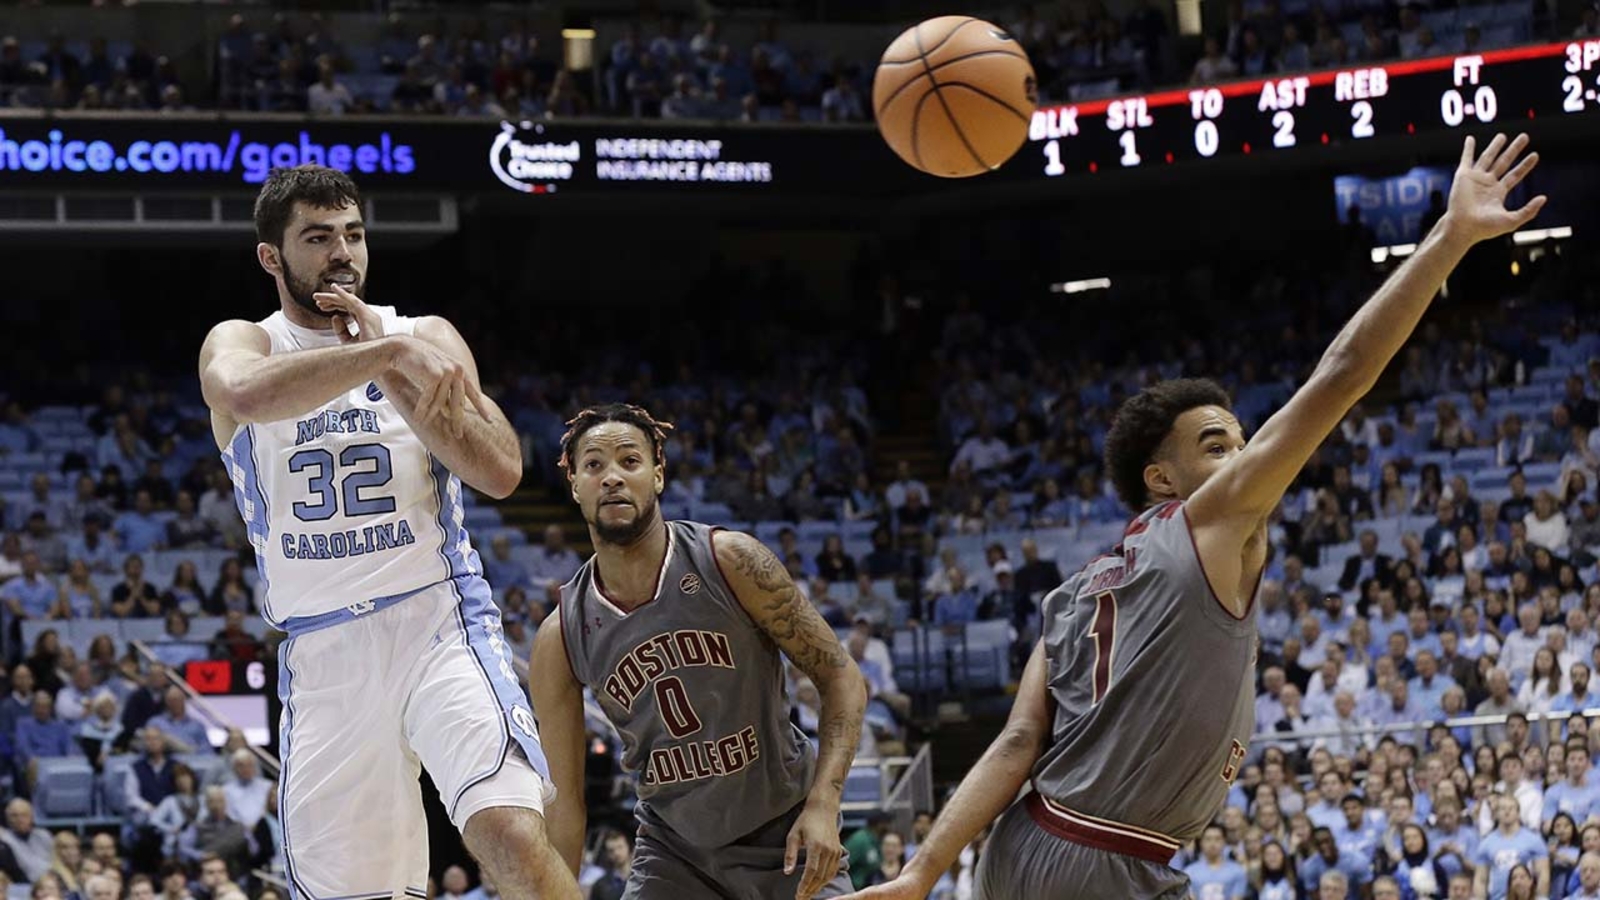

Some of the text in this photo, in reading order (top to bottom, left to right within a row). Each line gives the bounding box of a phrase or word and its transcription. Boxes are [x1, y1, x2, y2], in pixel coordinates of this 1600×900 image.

[1029, 40, 1600, 141] BLK STL TO AST REB FT 3P
[595, 138, 722, 160] INDEPENDENT
[1043, 139, 1065, 176] 1
[1119, 130, 1141, 167] 1
[1194, 119, 1219, 157] 0
[1272, 110, 1296, 148] 2
[1351, 101, 1375, 138] 2
[1440, 85, 1498, 127] 0-0
[596, 161, 773, 182] INSURANCE AGENTS
[295, 408, 381, 446] NORTH
[288, 442, 396, 522] 32
[280, 519, 415, 560] CAROLINA
[245, 661, 266, 690] 6
[603, 629, 736, 714] BOSTON
[1086, 589, 1118, 709] 1
[653, 675, 702, 740] 0
